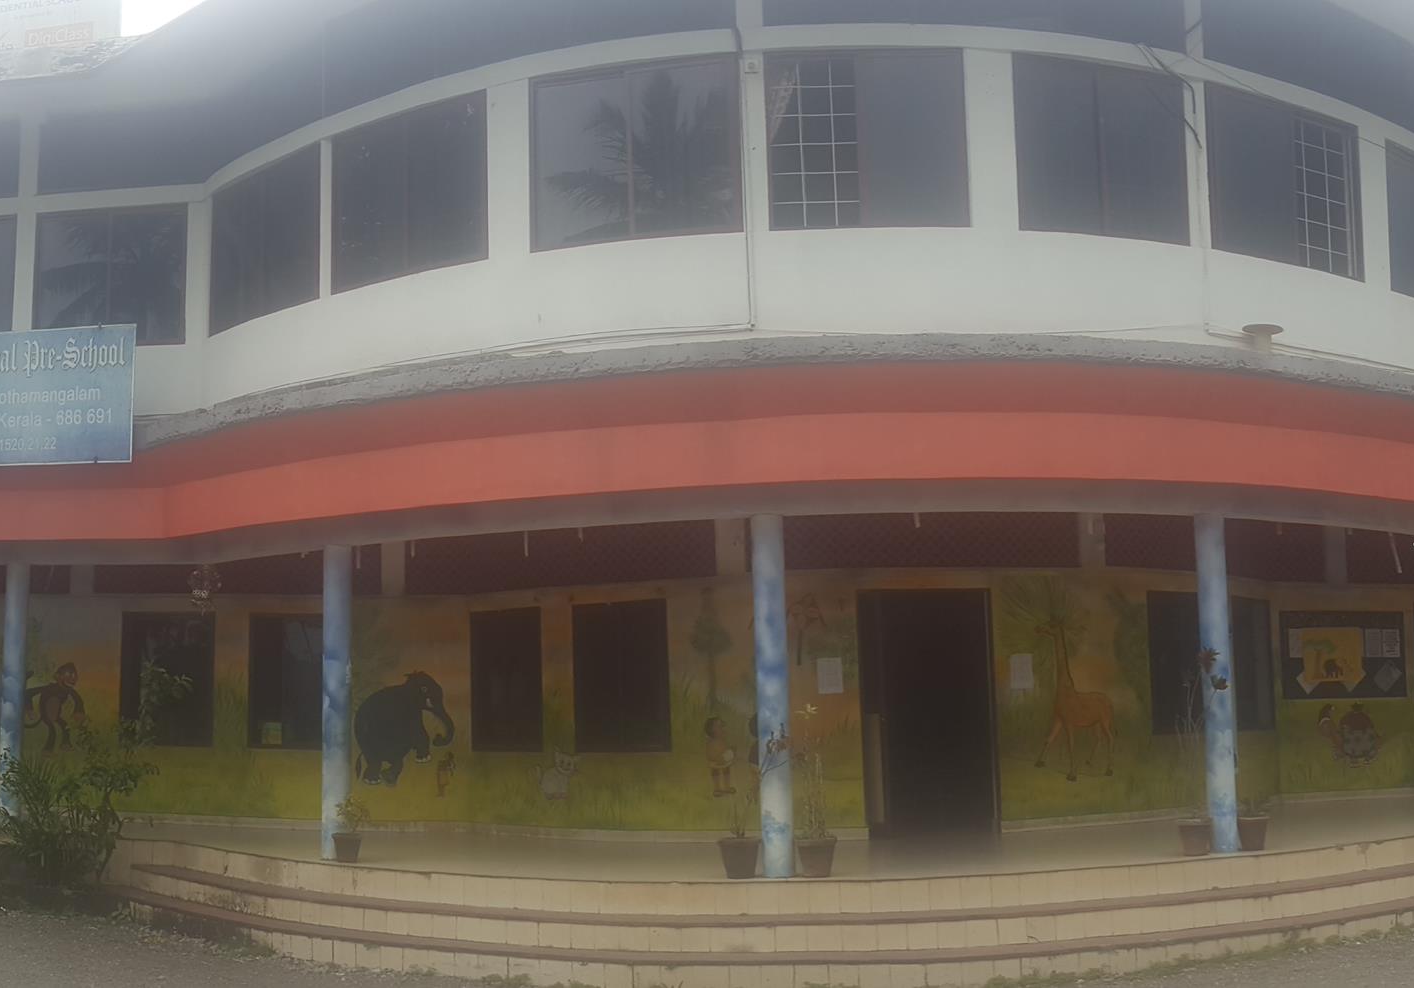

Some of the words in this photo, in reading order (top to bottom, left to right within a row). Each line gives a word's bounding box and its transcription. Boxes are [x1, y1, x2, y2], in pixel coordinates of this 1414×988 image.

[28, 27, 90, 46] DigiClass
[23, 336, 127, 378] Pre-School
[57, 409, 83, 426] 686
[86, 407, 112, 425] 691
